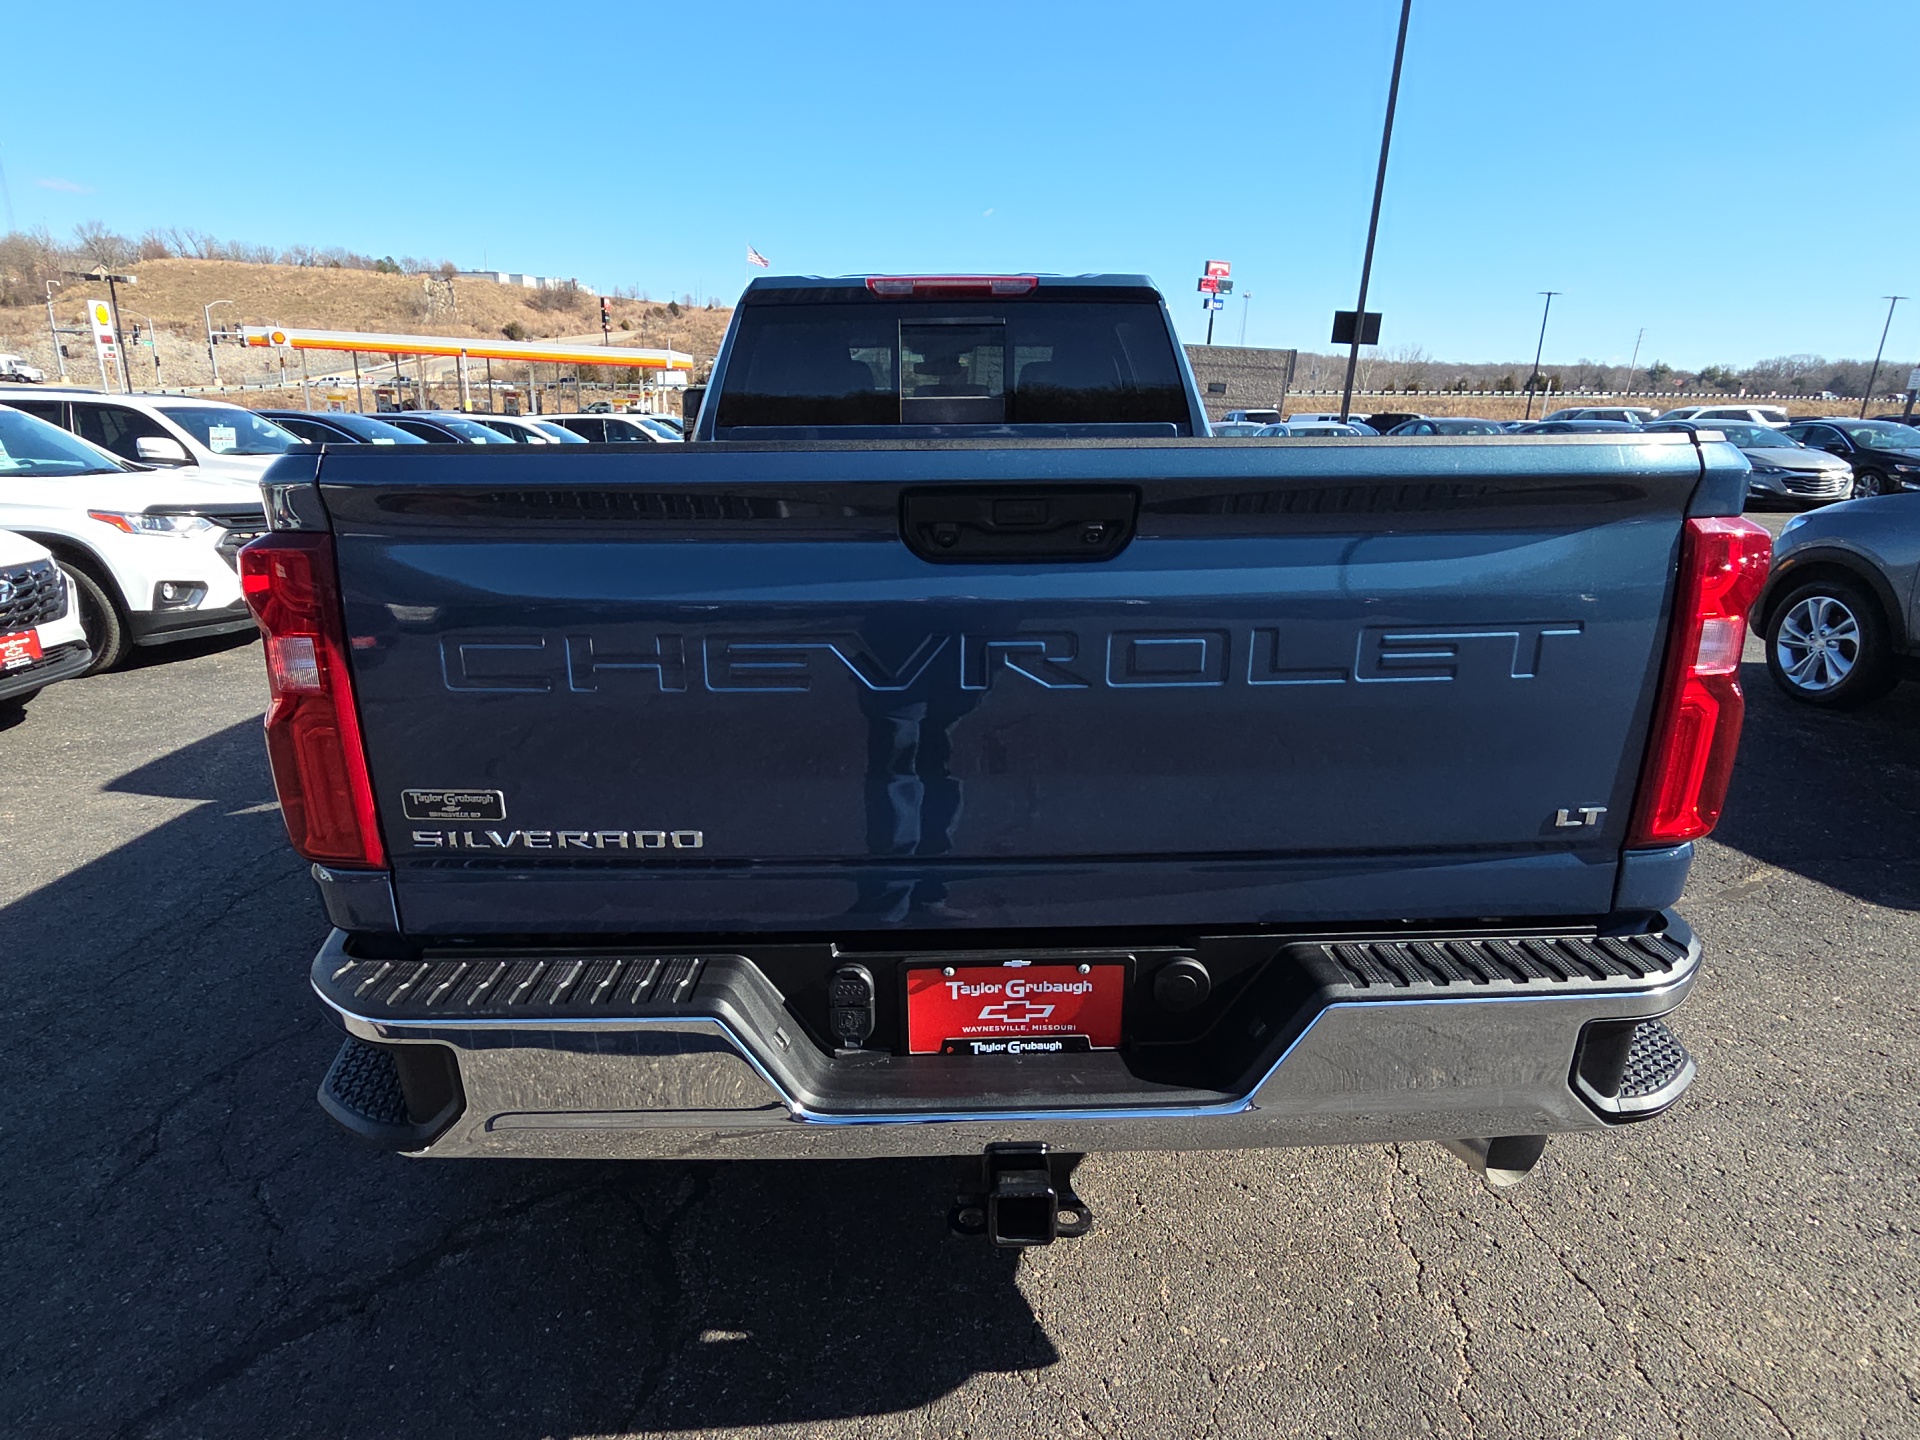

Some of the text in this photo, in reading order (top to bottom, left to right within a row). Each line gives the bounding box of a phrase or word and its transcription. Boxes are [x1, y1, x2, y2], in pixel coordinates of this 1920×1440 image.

[439, 620, 1585, 693] CHEVROLET
[409, 792, 442, 805] Taylor
[1555, 806, 1608, 827] LT
[411, 829, 704, 849] SILVERADO
[945, 979, 1093, 1000] Taylor Grubaugh
[962, 1025, 1029, 1033] WAYNESVILLE,
[969, 1040, 1063, 1055] Taylor Grubaugh
